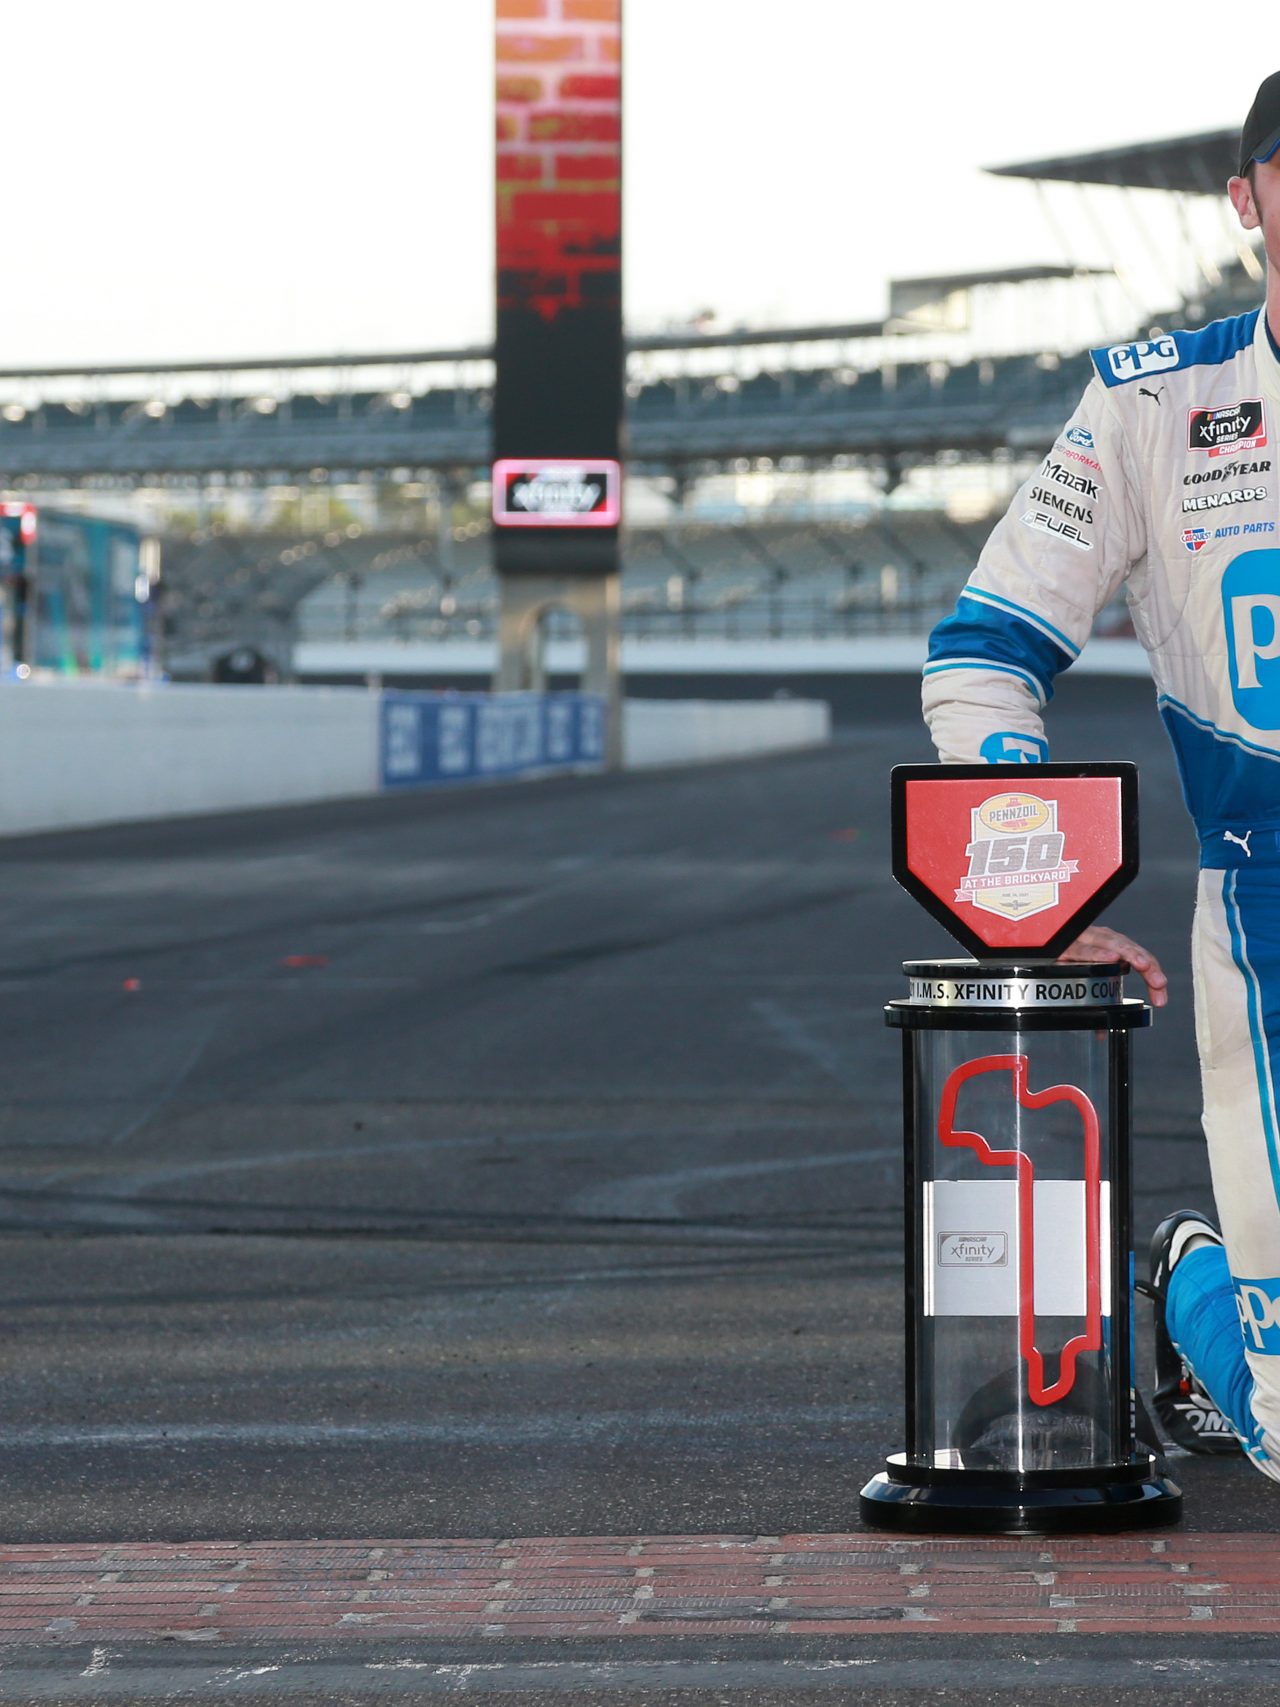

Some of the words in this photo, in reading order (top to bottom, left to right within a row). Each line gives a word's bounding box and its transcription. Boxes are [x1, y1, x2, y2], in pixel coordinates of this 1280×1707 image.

[1112, 340, 1175, 370] PPG
[1068, 427, 1094, 446] Ford
[1199, 416, 1252, 441] xfinity
[1216, 431, 1239, 443] SERIES
[1041, 459, 1099, 499] Mazak
[1029, 486, 1094, 524] SIEMENS
[1182, 486, 1267, 512] MENARDS
[1033, 512, 1090, 546] FUEL
[1215, 525, 1240, 538] AUTO
[1243, 522, 1275, 534] PARTS
[989, 804, 1039, 823] PENNZOIL
[966, 833, 1064, 876] 150
[964, 879, 978, 889] AT
[981, 877, 1001, 888] THE
[1004, 870, 1066, 885] BRICKYARD
[917, 982, 949, 999] I.M.S.
[954, 983, 1029, 1000] XFINITY
[1035, 983, 1087, 1000] ROAD
[951, 1243, 995, 1259] xfinity
[1185, 1409, 1231, 1431] OM
